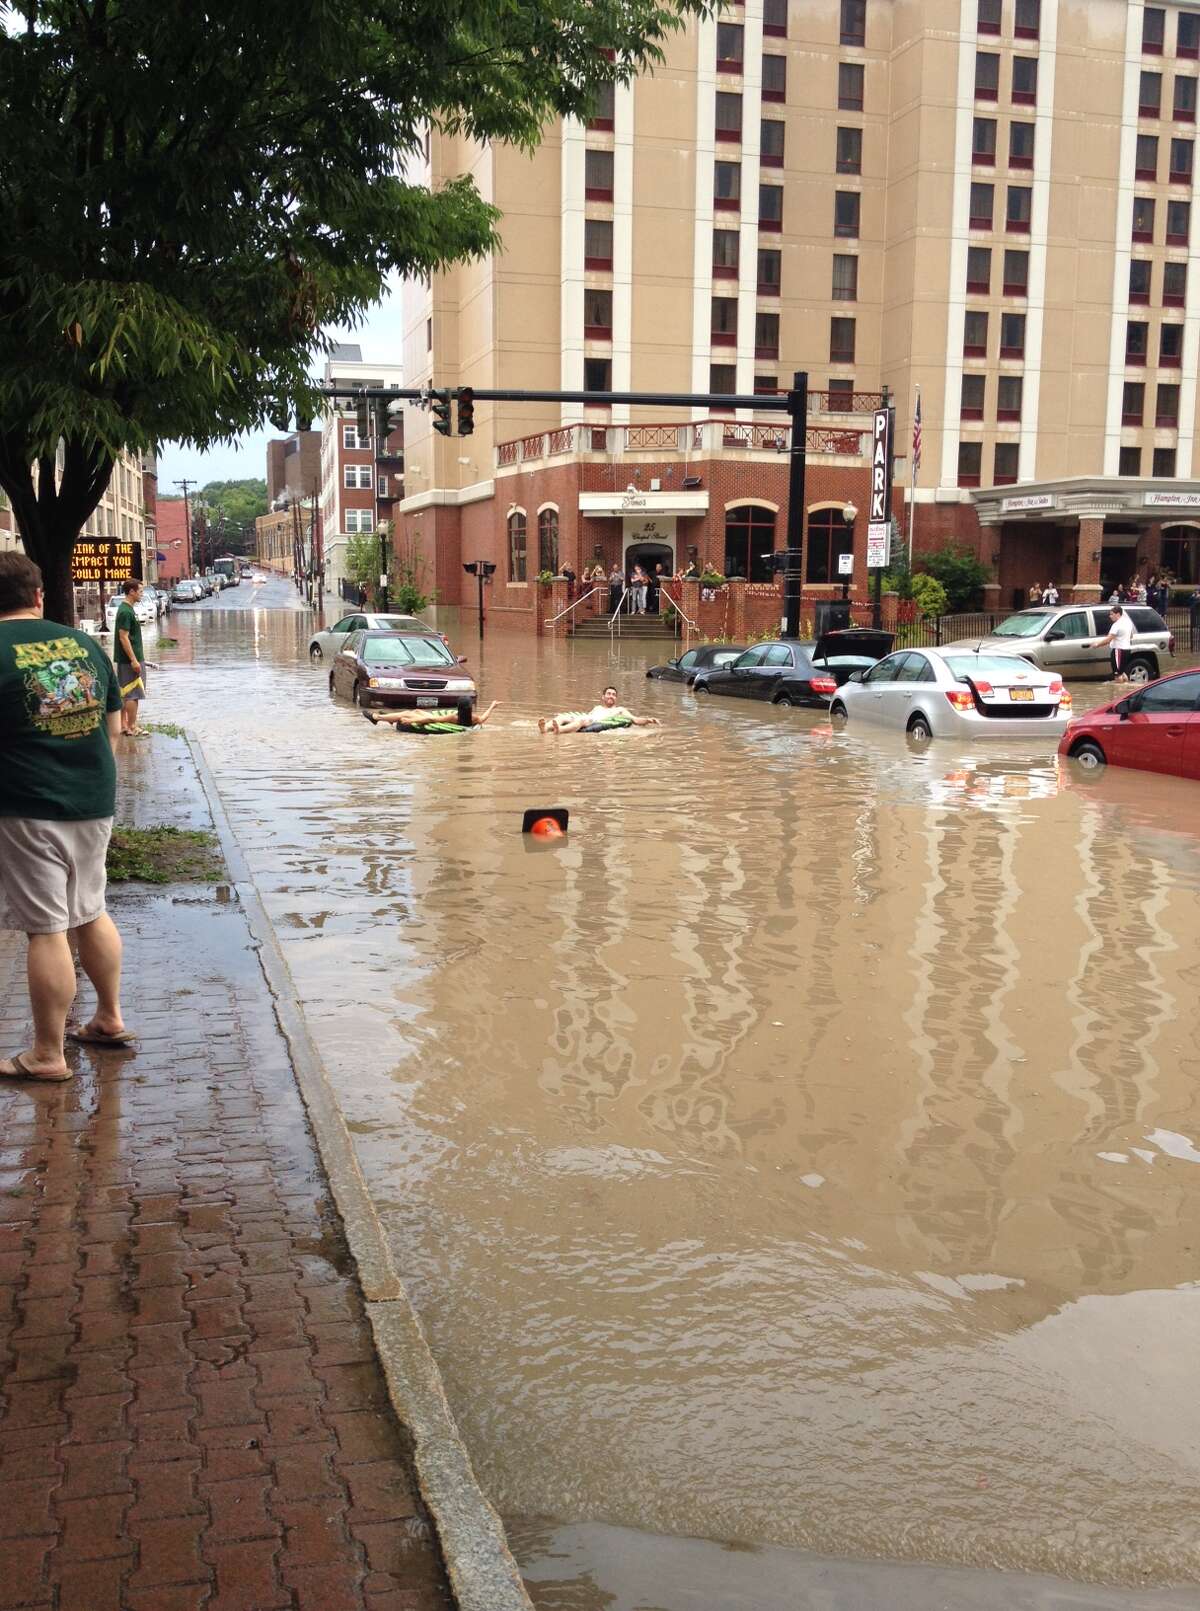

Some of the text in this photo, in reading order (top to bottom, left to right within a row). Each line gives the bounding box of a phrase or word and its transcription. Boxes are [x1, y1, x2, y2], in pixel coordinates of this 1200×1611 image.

[873, 415, 885, 516] PARK
[73, 543, 133, 554] INK OF THE
[112, 556, 131, 566] YOU
[104, 569, 132, 578] MAKE
